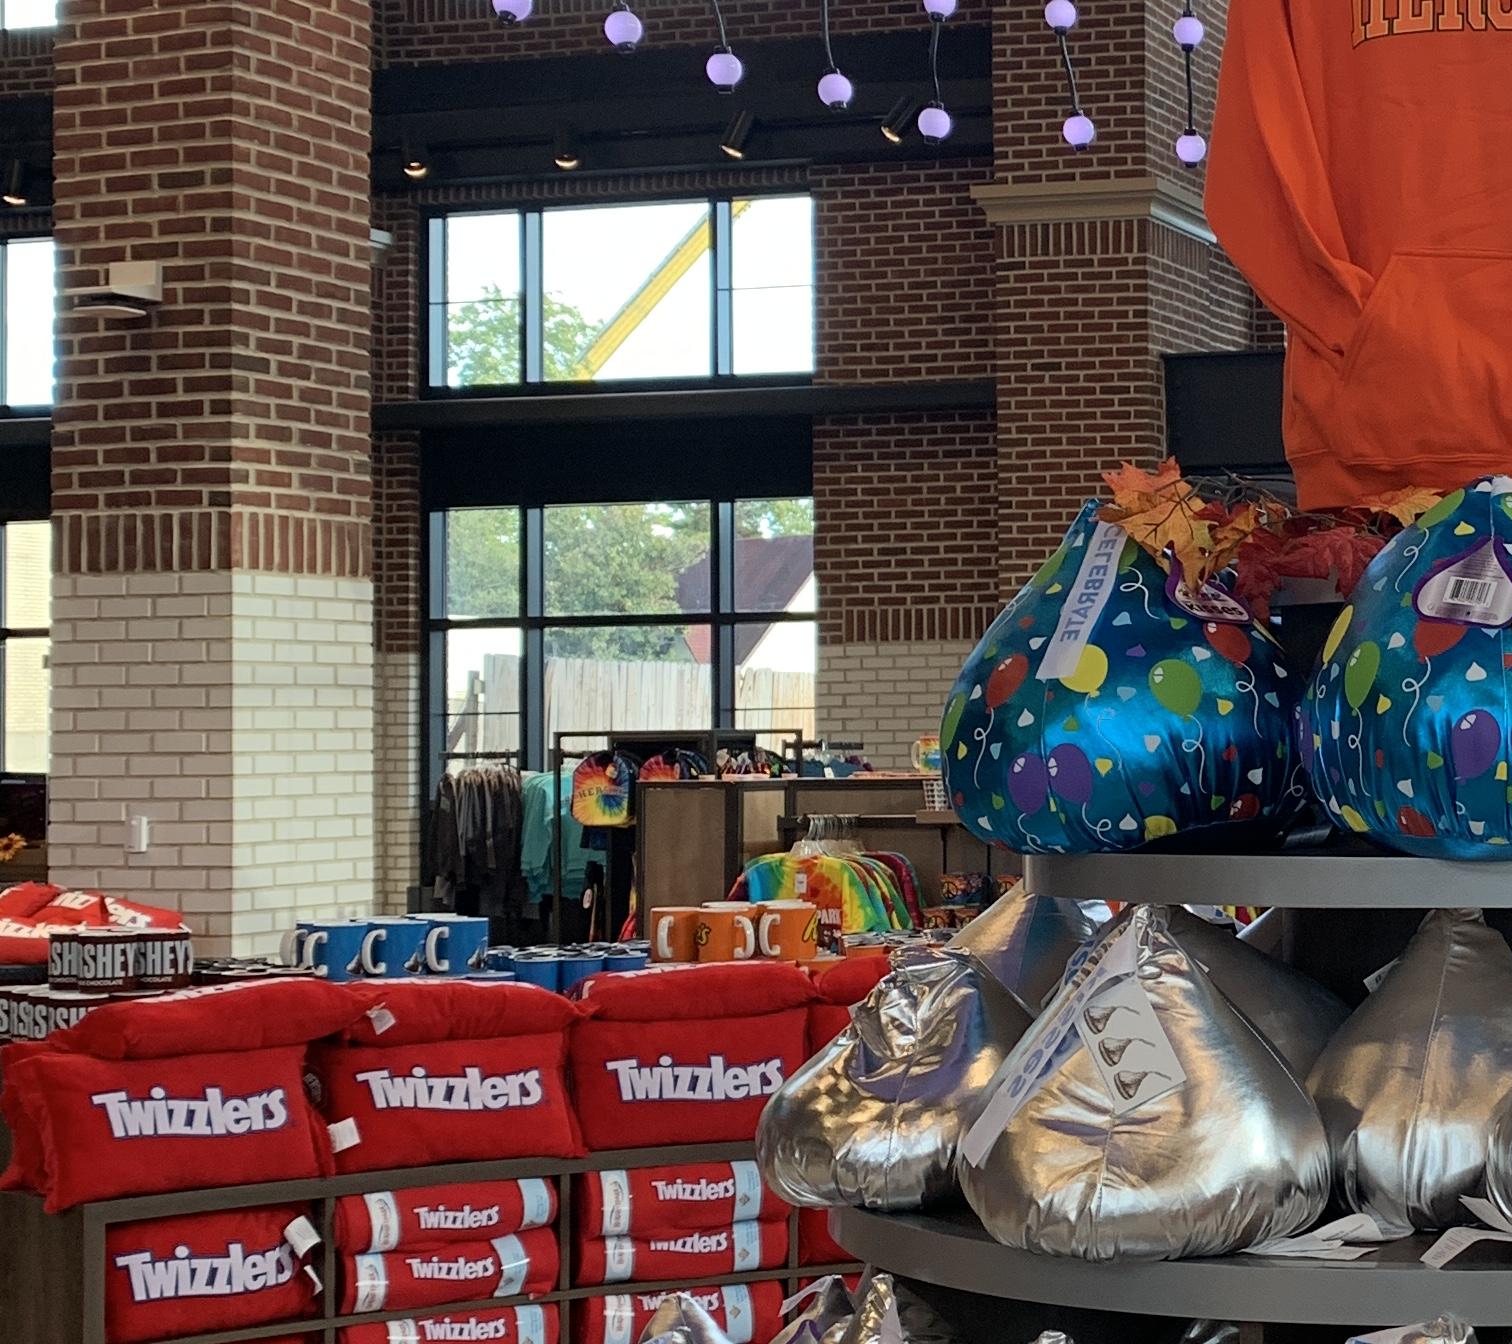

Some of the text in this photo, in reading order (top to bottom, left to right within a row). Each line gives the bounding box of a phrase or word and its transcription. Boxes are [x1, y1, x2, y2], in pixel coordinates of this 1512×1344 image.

[356, 1066, 543, 1112] Twizzlers
[607, 1056, 784, 1101] Twizzlers
[92, 1087, 288, 1138] Twizzlers
[651, 1178, 735, 1201] Twizzlers
[413, 1205, 500, 1230] Twizzlers
[650, 1232, 728, 1254] wizzlers
[115, 1242, 294, 1303] Twizzlers
[406, 1255, 494, 1281] Twizzlers
[418, 1316, 506, 1341] Twizzlers
